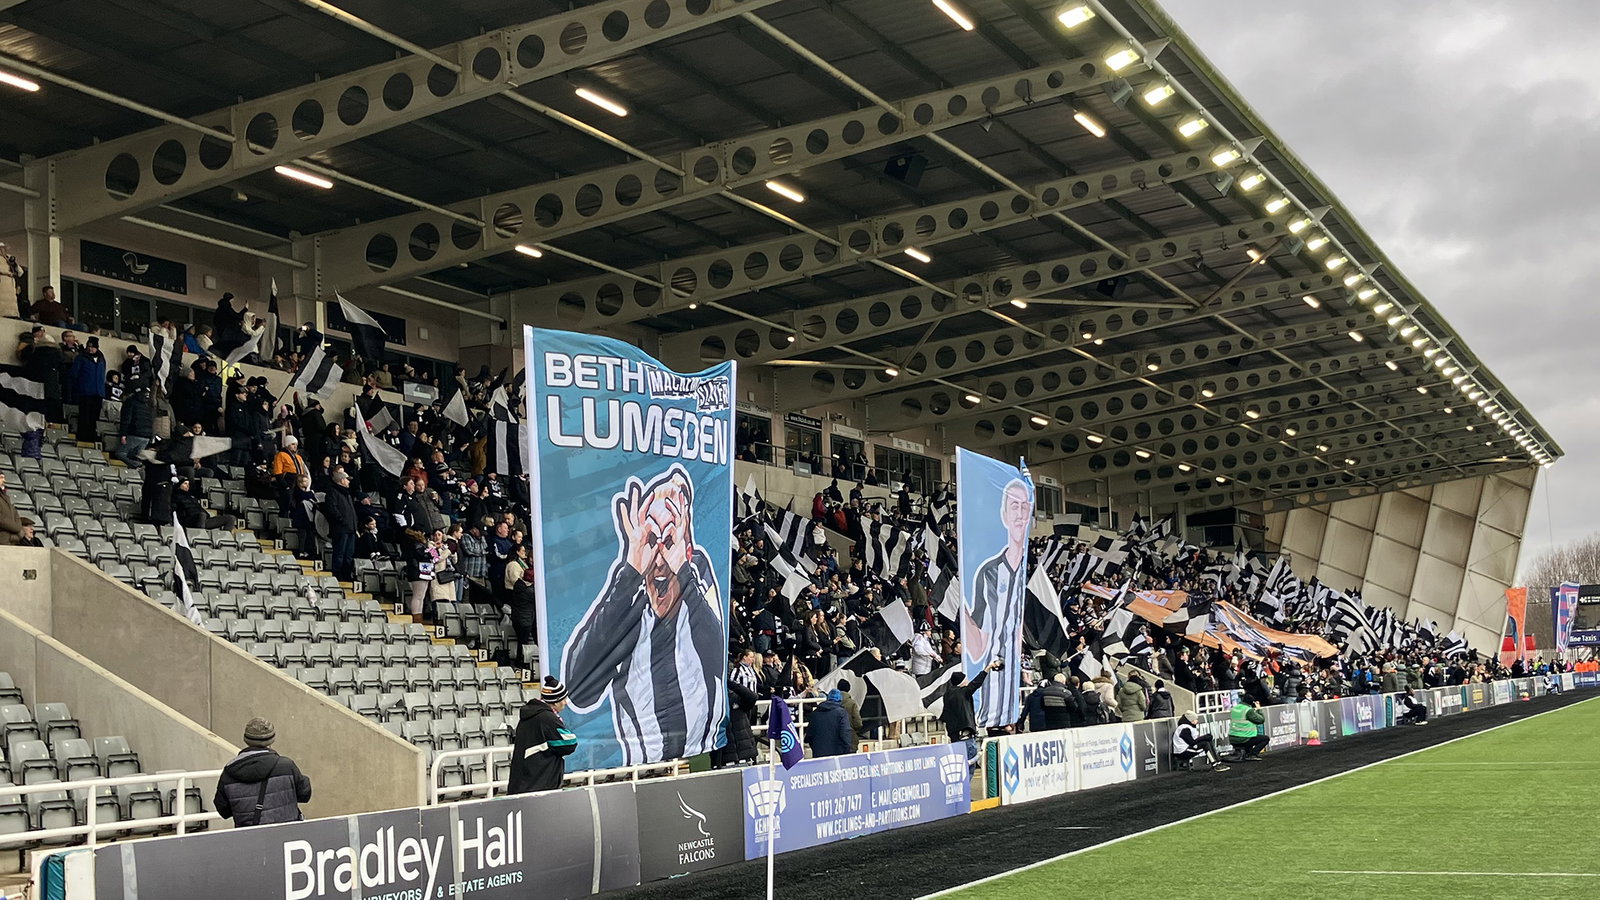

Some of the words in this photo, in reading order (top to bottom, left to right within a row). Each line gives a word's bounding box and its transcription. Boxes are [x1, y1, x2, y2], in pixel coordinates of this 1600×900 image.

[545, 352, 645, 394] BETH
[546, 395, 728, 465] LUMSDEN
[1023, 739, 1068, 769] MASFIX
[790, 772, 823, 790] SPECIALISTS
[823, 771, 830, 784] IN
[830, 767, 859, 784] SUSPENDED
[817, 799, 832, 818] 0191
[834, 796, 846, 814] 267
[848, 794, 862, 813] 7477
[816, 804, 921, 839] WWW.CEILINGS-AND-PARTITIONS.COM
[283, 825, 445, 900] Bradley
[458, 809, 523, 873] Hall
[678, 838, 715, 852] NEWCASTLE
[679, 848, 716, 865] FALCONS
[437, 886, 444, 898] &
[448, 878, 484, 896] ESTATE
[486, 871, 523, 889] AGENTS
